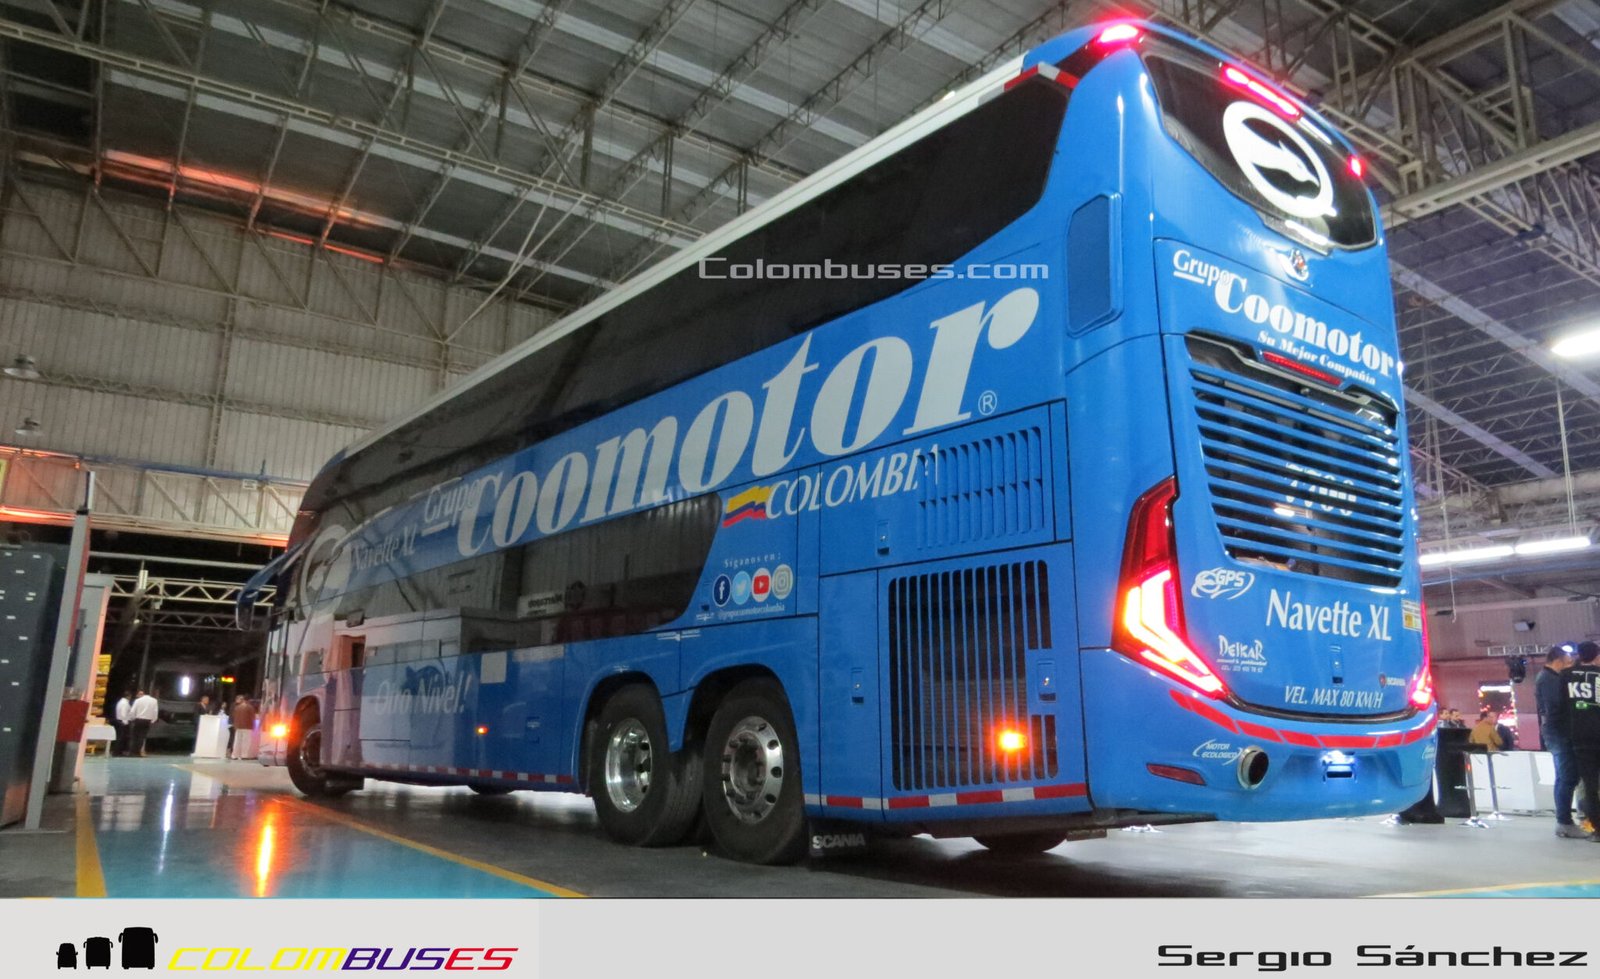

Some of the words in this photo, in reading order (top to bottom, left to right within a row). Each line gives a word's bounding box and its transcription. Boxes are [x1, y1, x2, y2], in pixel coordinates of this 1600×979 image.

[1173, 249, 1230, 287] Grupo
[1215, 272, 1394, 377] Coomotor
[1258, 330, 1276, 346] Su
[1280, 338, 1318, 361] Mejor
[457, 286, 1040, 557] Coomotor
[1266, 588, 1362, 638] Navette
[1367, 604, 1392, 641] XL
[1311, 687, 1340, 706] MAX
[1340, 690, 1355, 708] 80
[812, 833, 866, 849] SCANIA
